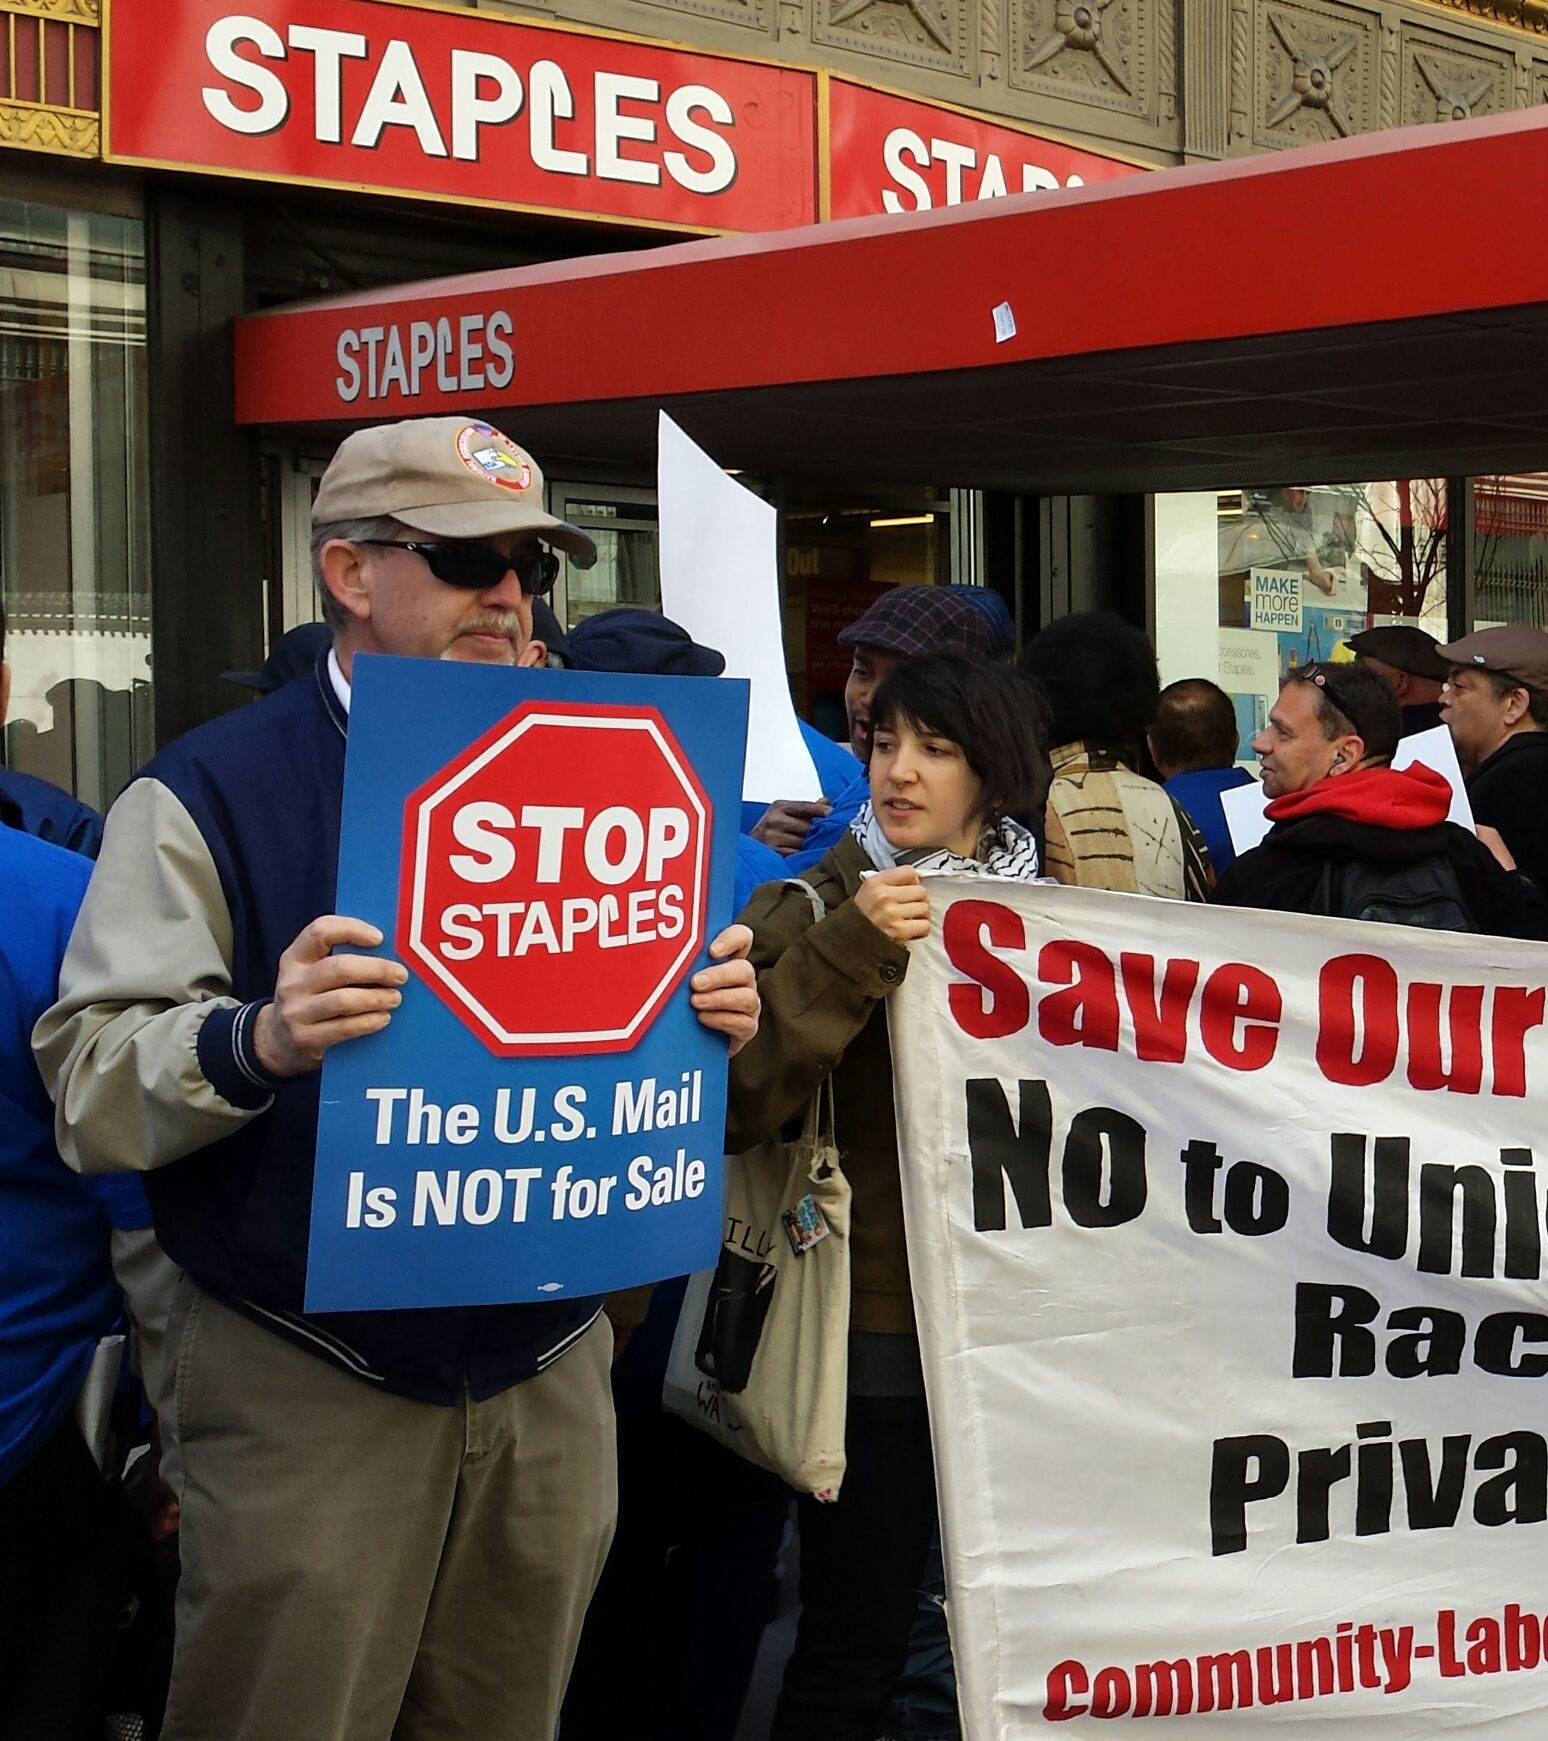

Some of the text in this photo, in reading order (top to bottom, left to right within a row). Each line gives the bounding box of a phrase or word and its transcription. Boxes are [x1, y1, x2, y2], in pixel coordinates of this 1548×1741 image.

[201, 15, 738, 195] STAPLES
[881, 127, 1084, 214] STA
[336, 311, 515, 402] STAPLES
[1255, 575, 1299, 595] MAKE
[1255, 593, 1299, 612] more
[1255, 611, 1299, 626] HAPPEN
[449, 801, 690, 885] STOP
[439, 884, 685, 960] STAPLES
[943, 899, 1283, 1071] Save
[1315, 953, 1546, 1098] Our
[366, 1070, 702, 1145] The U.S. Mail
[346, 1149, 706, 1229] Is NOT for Sale
[1180, 1139, 1290, 1237] to
